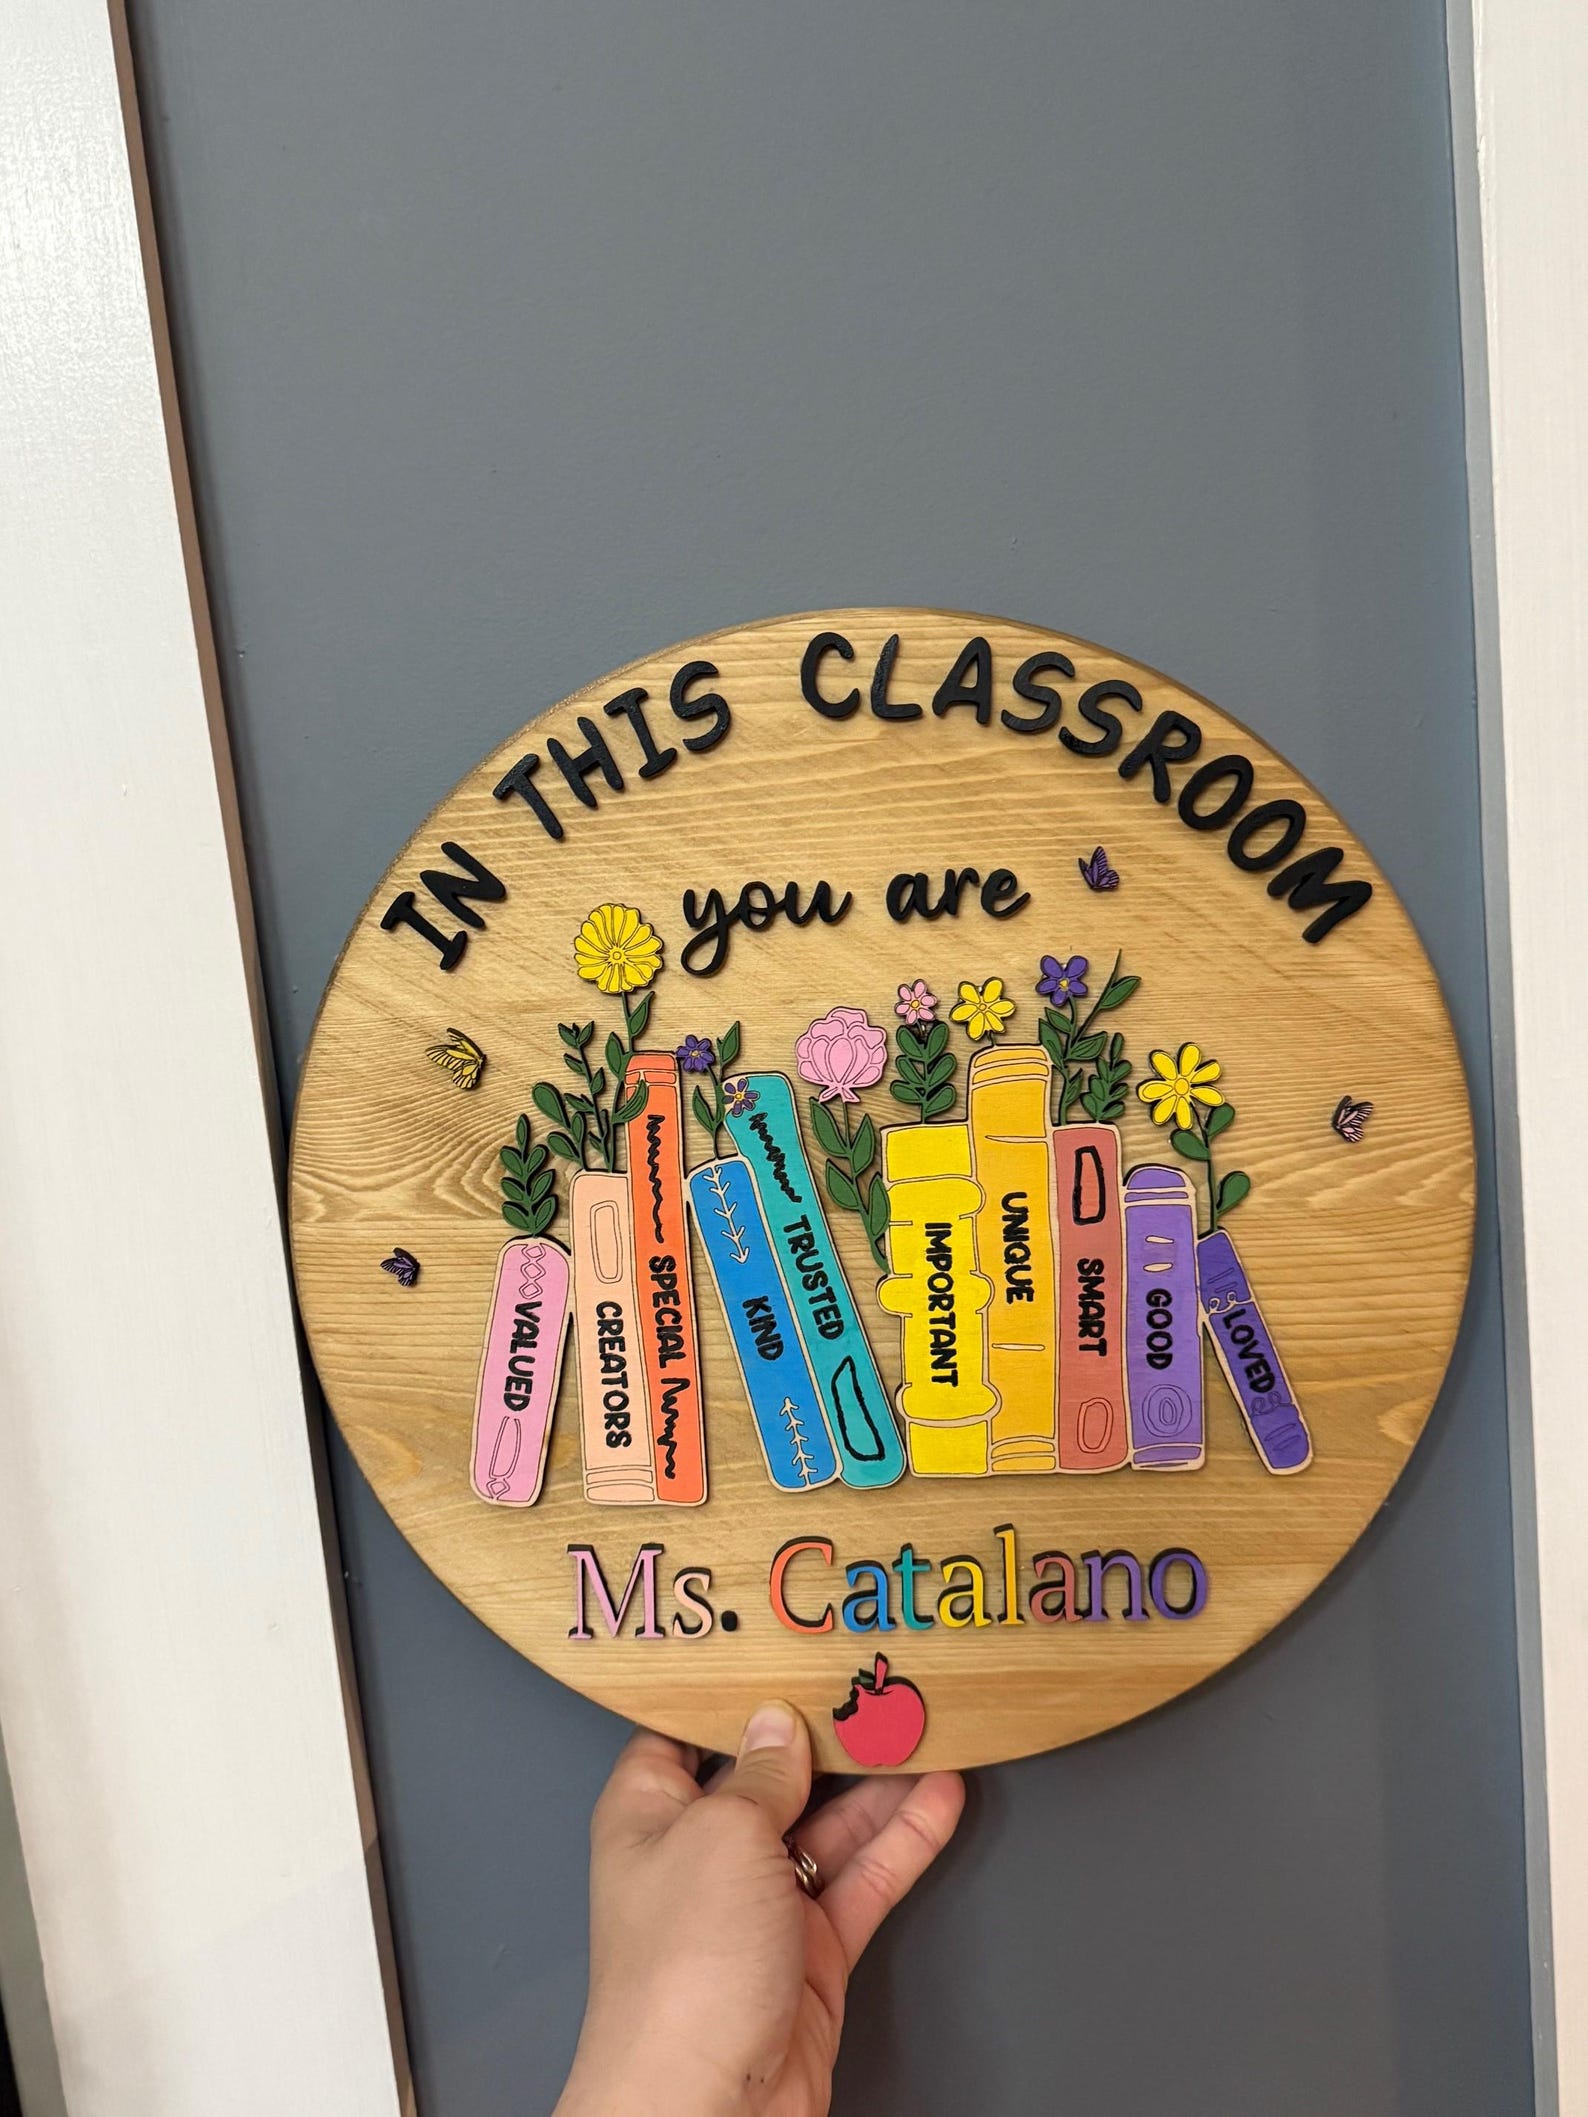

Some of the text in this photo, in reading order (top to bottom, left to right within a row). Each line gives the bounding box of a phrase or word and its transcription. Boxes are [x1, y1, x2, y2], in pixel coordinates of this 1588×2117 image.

[381, 631, 1373, 972] IN THIS CLASSROOM
[681, 868, 1031, 979] you are
[783, 1213, 846, 1341] TRUSTED
[1000, 1191, 1035, 1304] UNIQUE
[503, 1301, 543, 1412] VALUED
[648, 1254, 684, 1369] SPECIAL
[742, 1295, 786, 1361] KIND
[924, 1222, 960, 1388] IMPORTANT
[1076, 1258, 1108, 1357] SMART
[1145, 1287, 1174, 1370] GOOD
[1222, 1308, 1276, 1394] LOVED
[595, 1300, 632, 1449] CREATORS
[566, 1523, 1208, 1640] Ms. Catalano
